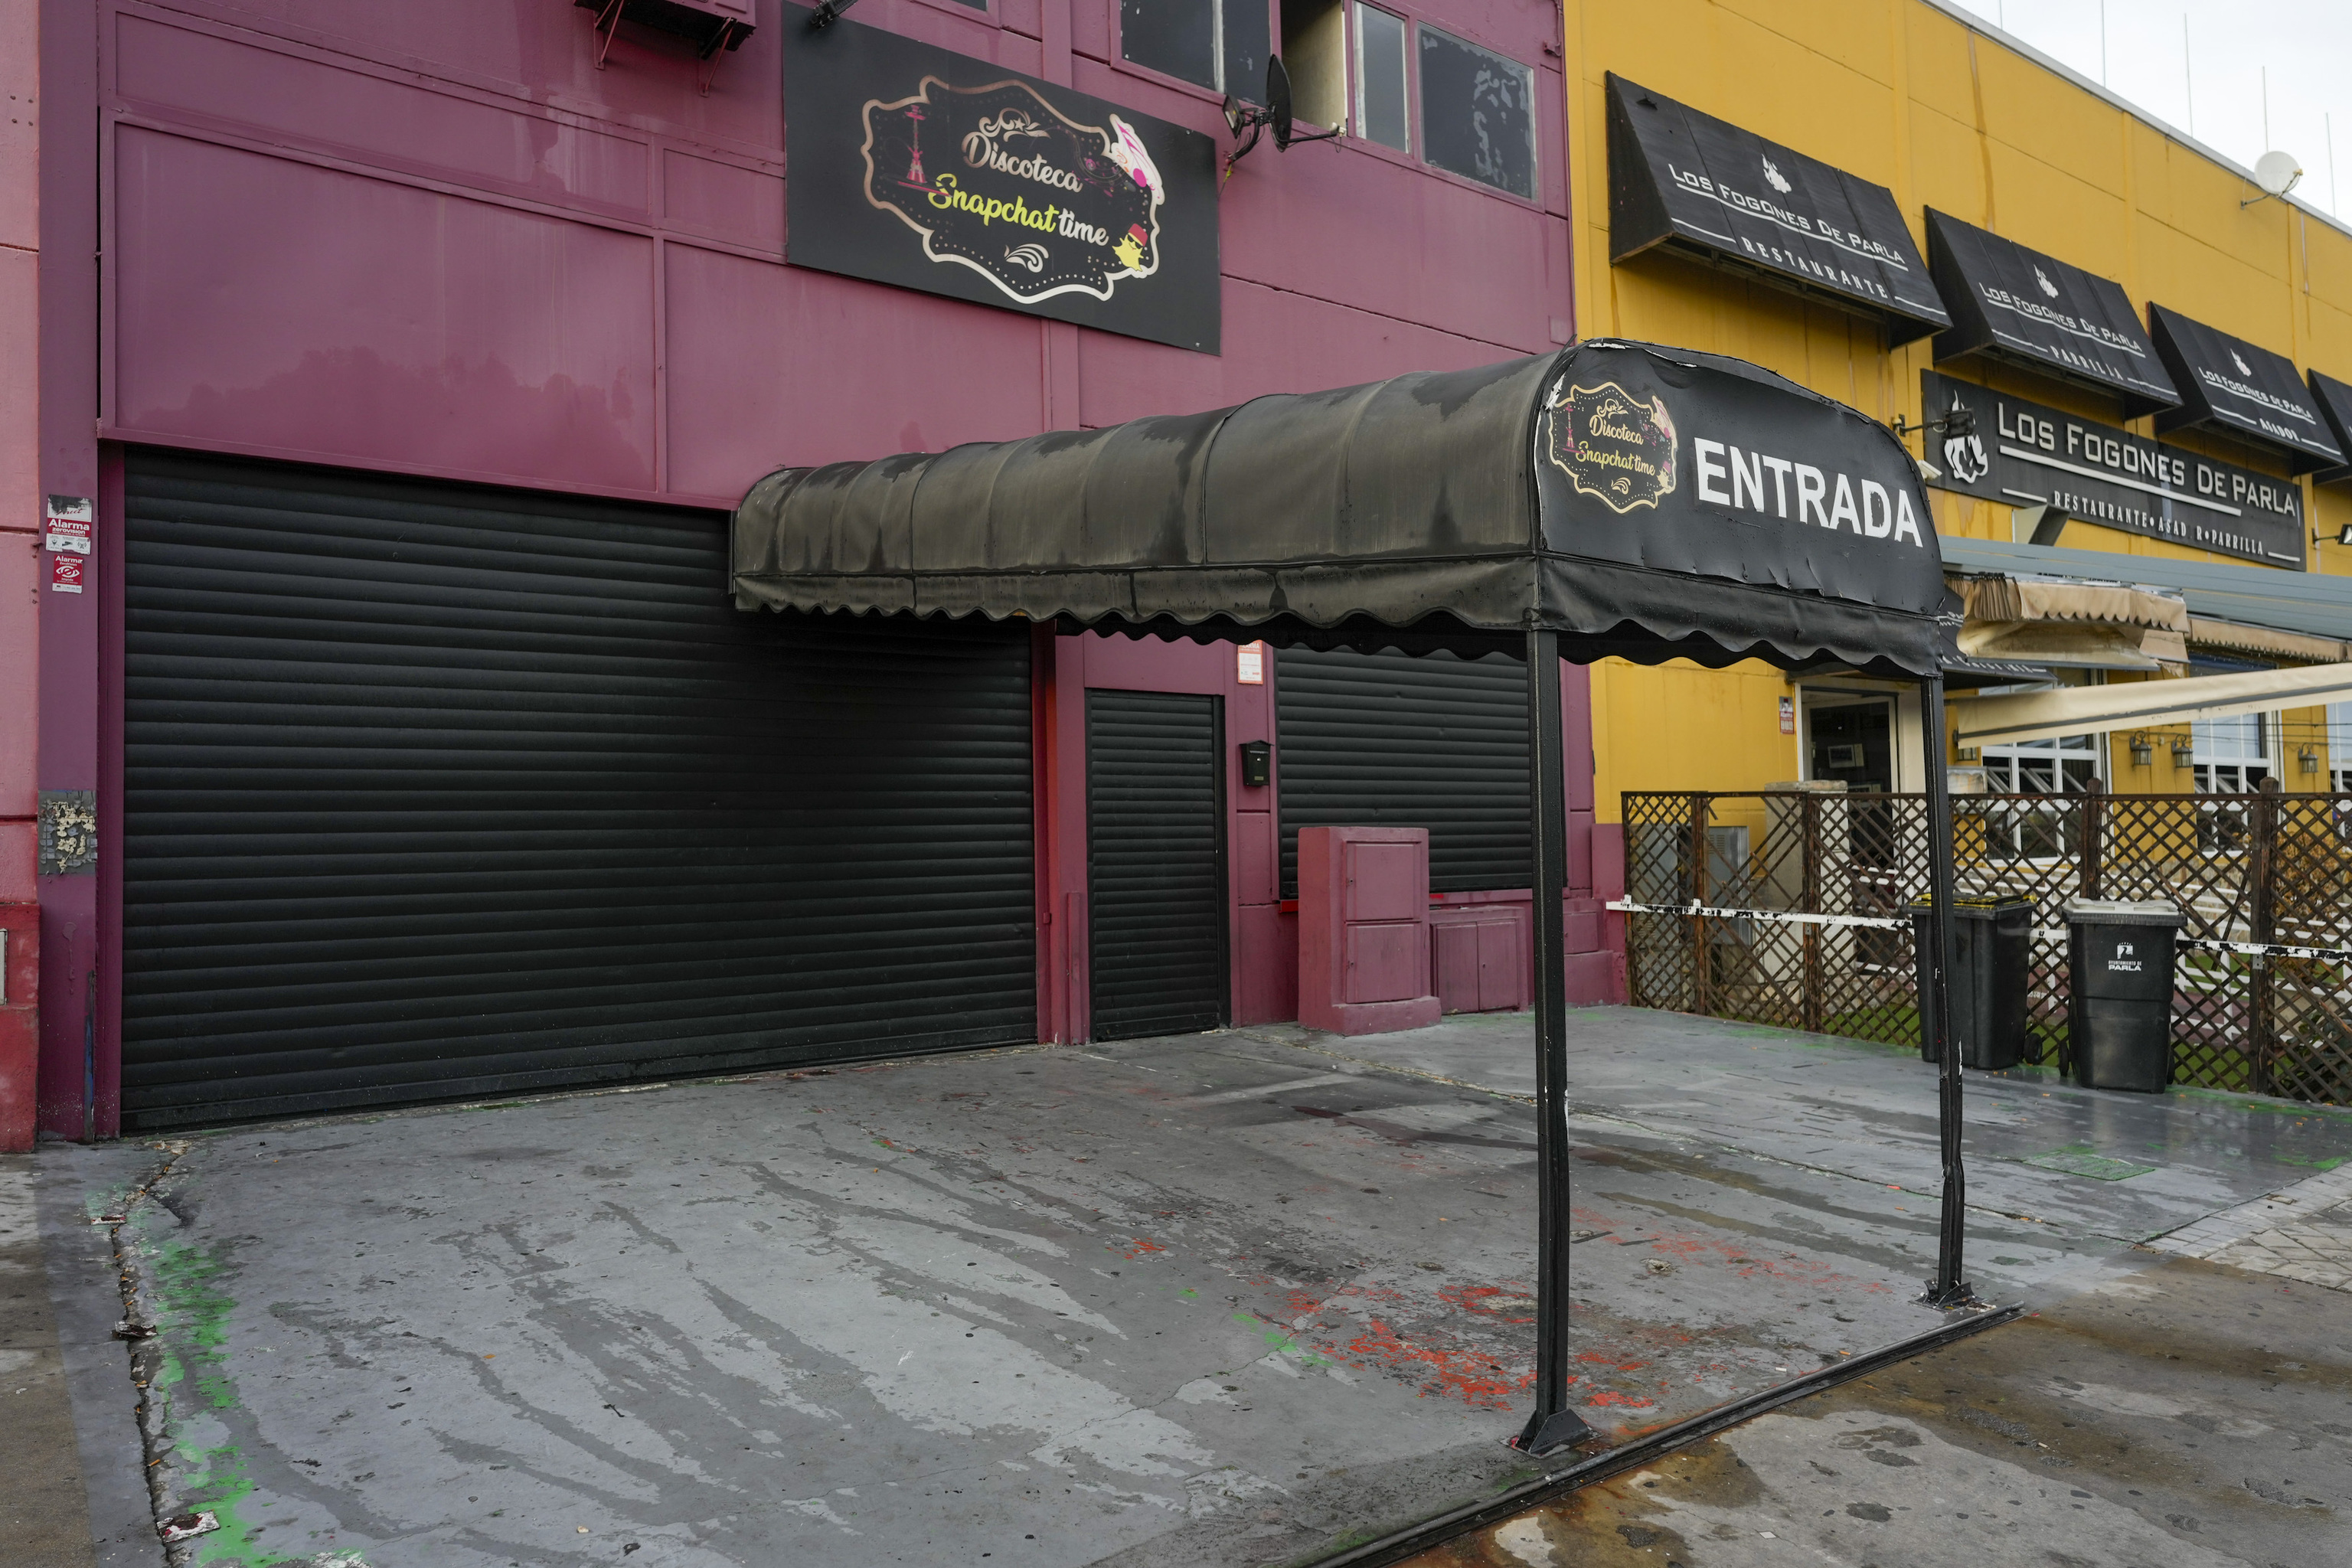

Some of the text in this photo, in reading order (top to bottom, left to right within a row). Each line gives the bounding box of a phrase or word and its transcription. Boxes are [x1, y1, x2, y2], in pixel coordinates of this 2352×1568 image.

[962, 132, 1083, 193] Discoteca
[928, 173, 1109, 247] Snapchat time
[1668, 164, 1714, 191] LOS
[1719, 183, 1811, 230] FOGONES
[1848, 232, 1906, 264] PARLA
[1741, 236, 1888, 299] RESTAURANTE
[1979, 283, 2011, 303] LOS
[2012, 296, 2076, 329] FOGONES
[2101, 328, 2142, 352] PARLA
[2050, 345, 2123, 381] PARRILLA
[2198, 367, 2221, 384] LOS
[2222, 376, 2269, 403] FOGONES
[2282, 400, 2314, 420] PARLA
[1576, 440, 1635, 469] Snapchat
[1589, 414, 1644, 446] Discoteca
[1998, 402, 2055, 451] LOS
[2067, 423, 2185, 486] FOGONES
[2233, 474, 2296, 517] PARLA
[2260, 418, 2300, 442] ASADOR
[1694, 437, 1923, 548] ENTRADA
[2054, 491, 2148, 528] RESTAURANTE
[2212, 530, 2263, 555] PARRILLA
[48, 518, 90, 531] Alarma
[55, 555, 83, 564] Alarma
